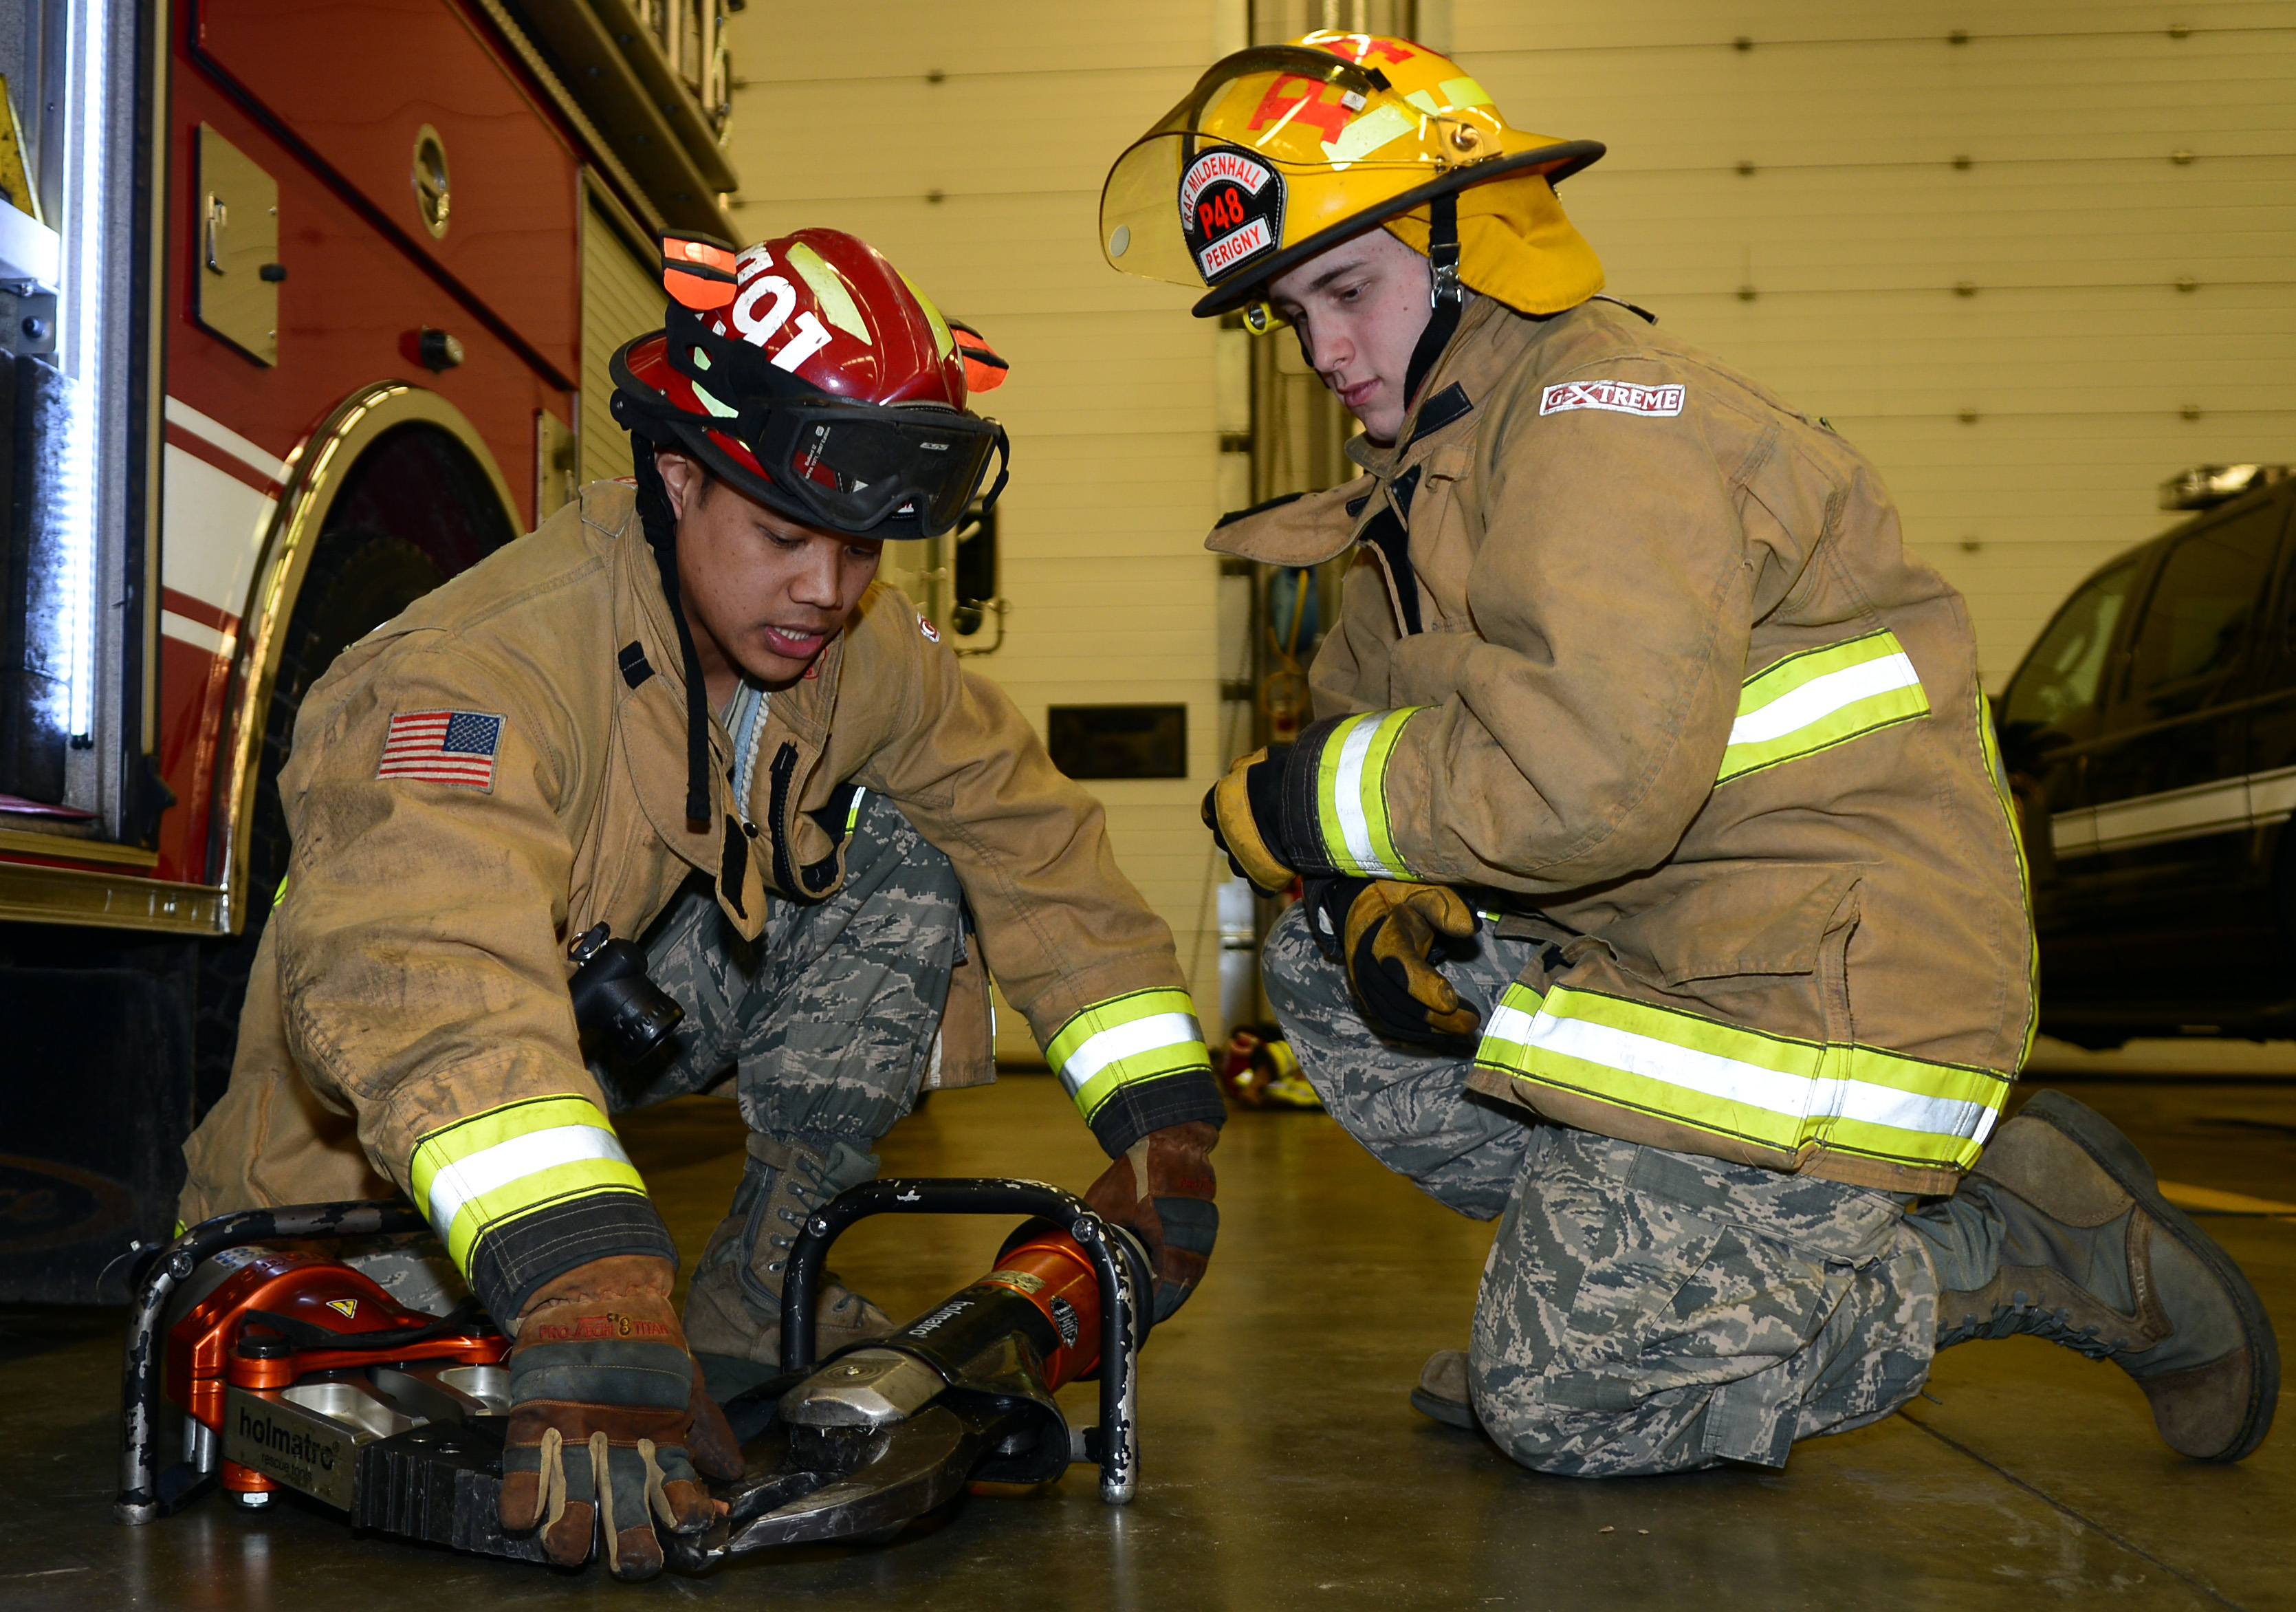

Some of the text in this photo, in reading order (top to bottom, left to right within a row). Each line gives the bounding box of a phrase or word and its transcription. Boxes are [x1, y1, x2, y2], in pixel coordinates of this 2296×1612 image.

[1183, 155, 1261, 224] RAF MILDENHALL
[1198, 186, 1245, 240] P48
[1205, 225, 1260, 271] PERIGNY
[1548, 383, 1681, 410] G-XTREME
[633, 1320, 670, 1336] TITAN
[261, 1452, 312, 1481] rescue tools
